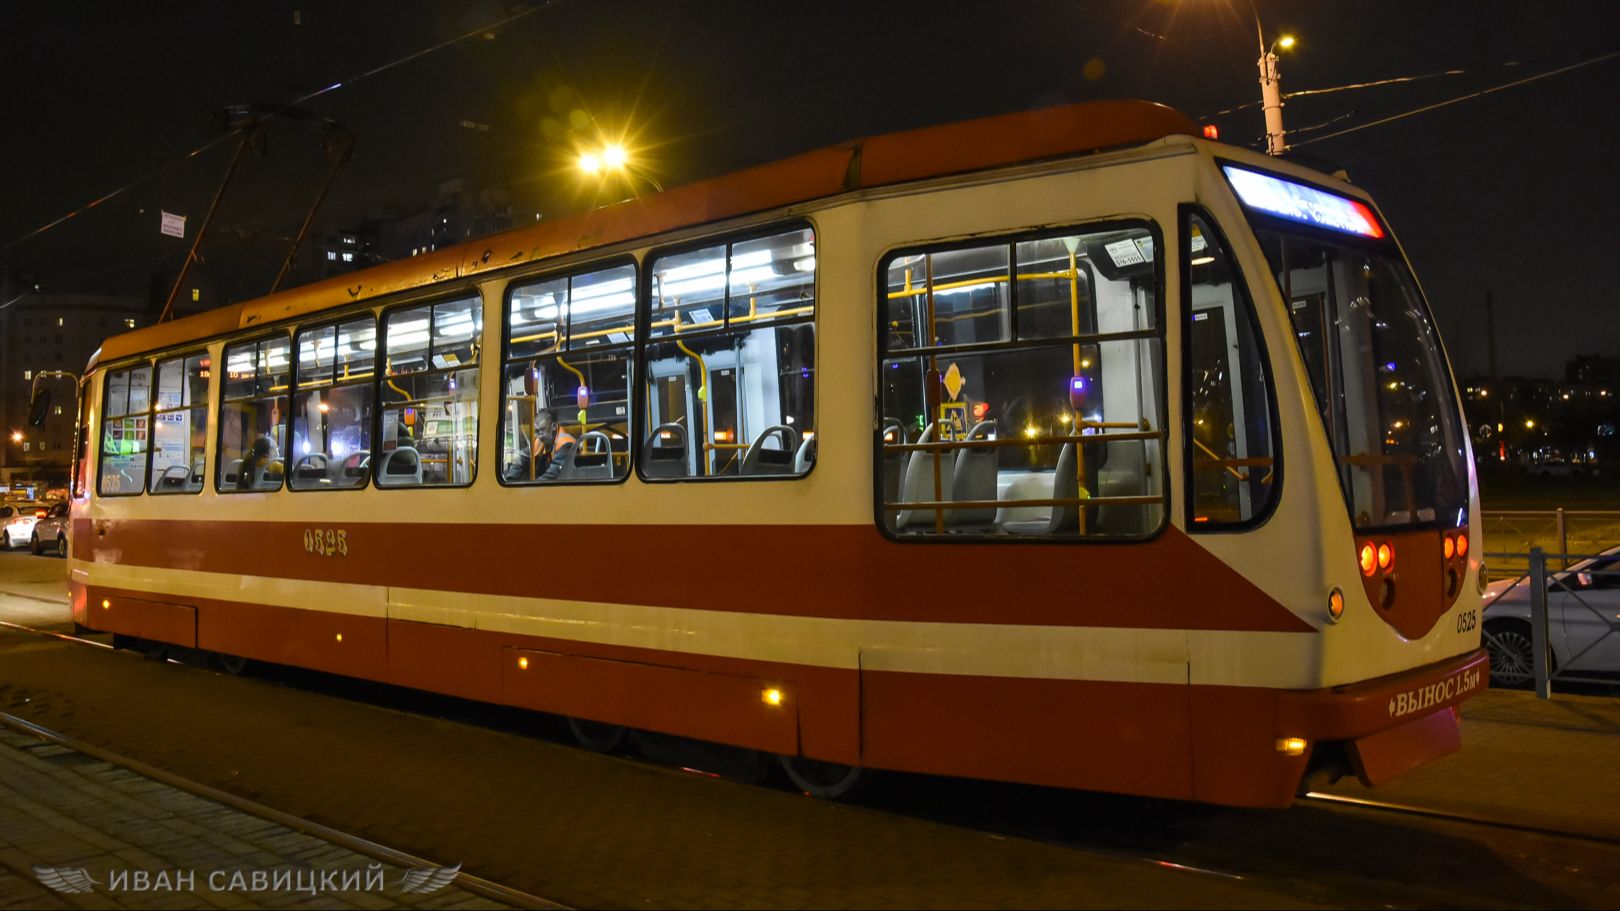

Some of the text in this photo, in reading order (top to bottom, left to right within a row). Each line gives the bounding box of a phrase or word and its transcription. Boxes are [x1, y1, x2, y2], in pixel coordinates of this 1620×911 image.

[303, 528, 348, 557] 0525
[1456, 609, 1477, 634] 0525
[1395, 678, 1454, 717] ВЫНОС
